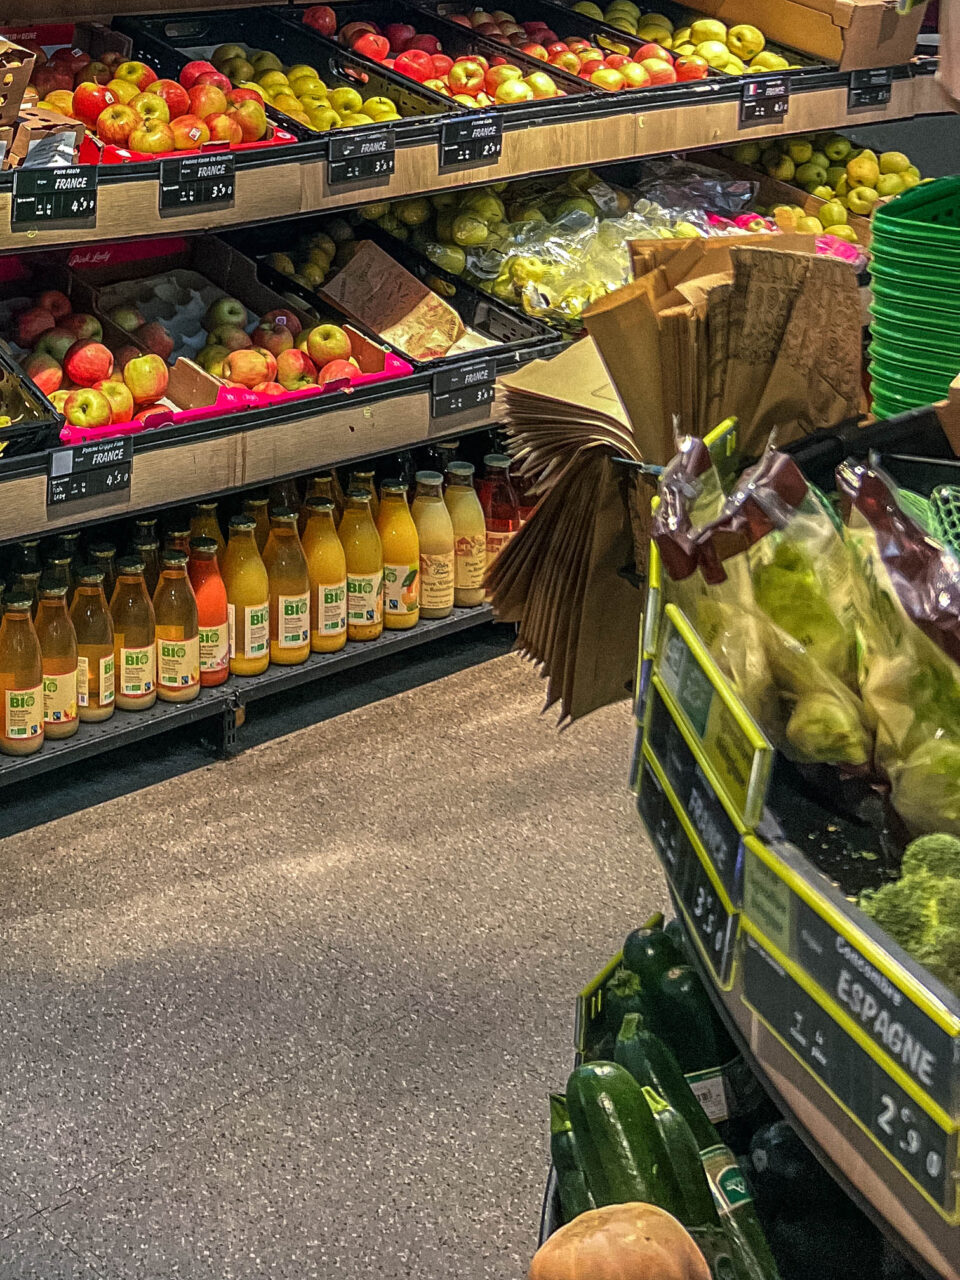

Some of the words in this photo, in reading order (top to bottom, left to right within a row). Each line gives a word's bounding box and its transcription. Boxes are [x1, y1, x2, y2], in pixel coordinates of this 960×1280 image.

[471, 125, 497, 138] FRANCE
[360, 141, 387, 153] FRANCE
[197, 164, 227, 178] FRANCE
[54, 177, 88, 190] FRANCE
[464, 369, 489, 384] FRANCE
[92, 448, 124, 465] FRANCE
[347, 583, 373, 594] BIO
[284, 602, 308, 616] BIO
[161, 646, 186, 658] BIO
[125, 654, 149, 666] BIO
[104, 659, 115, 675] BI
[43, 682, 58, 693] IO
[9, 696, 35, 709] BIO
[836, 969, 937, 1087] ESPAGNE
